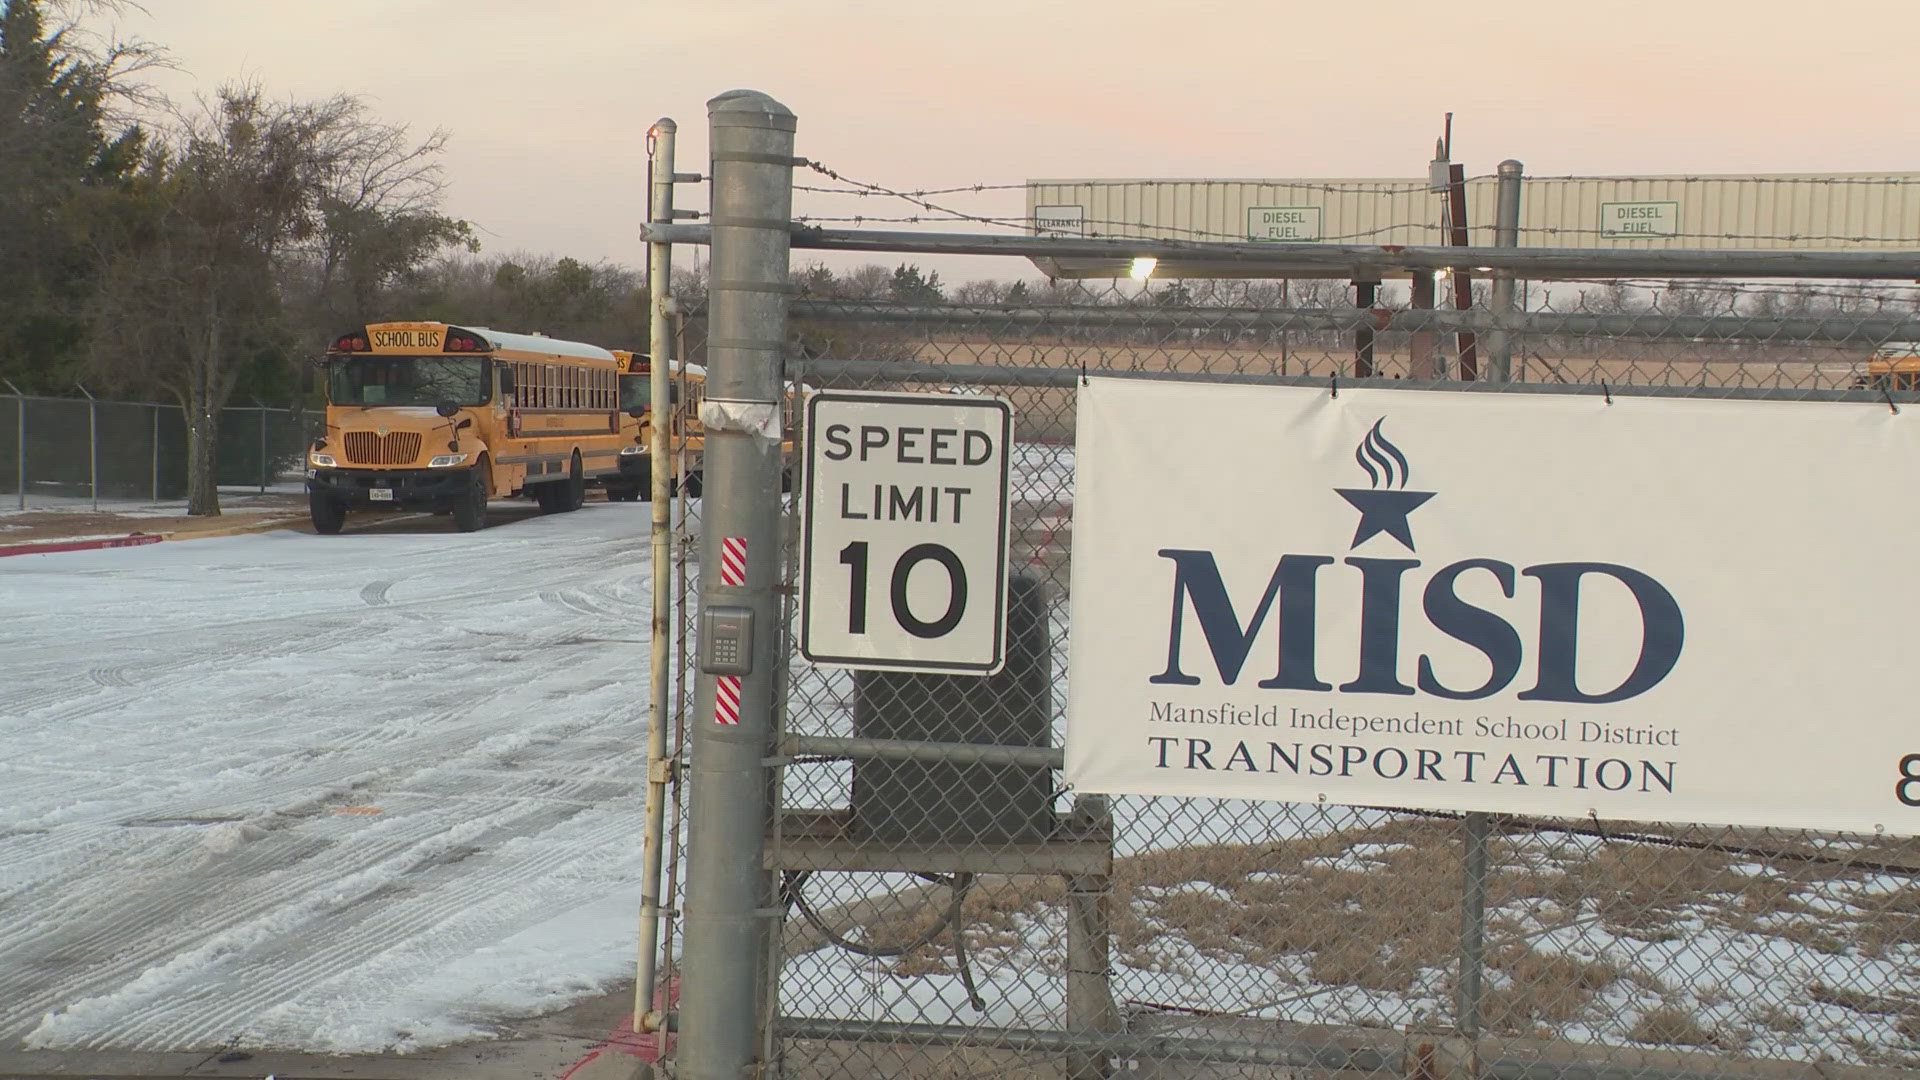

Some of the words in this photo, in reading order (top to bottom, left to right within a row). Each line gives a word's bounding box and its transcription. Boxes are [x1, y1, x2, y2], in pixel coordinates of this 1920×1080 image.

[1038, 217, 1080, 228] CLEARANCE
[1263, 212, 1306, 224] DIESEL
[1617, 207, 1663, 219] DIESEL
[1623, 222, 1656, 233] FUEL
[1268, 226, 1300, 238] FUEL
[375, 331, 415, 347] SCHOOL
[418, 331, 439, 348] BUS
[824, 423, 993, 466] SPEED
[841, 482, 972, 524] LIMIT
[839, 540, 968, 639] 10
[1148, 548, 1685, 705] MISD
[1149, 701, 1278, 727] Mansfield
[1290, 707, 1464, 738] Independent
[1475, 715, 1567, 741] School
[1580, 720, 1679, 747] District
[1147, 736, 1677, 794] TRANSPORTATION
